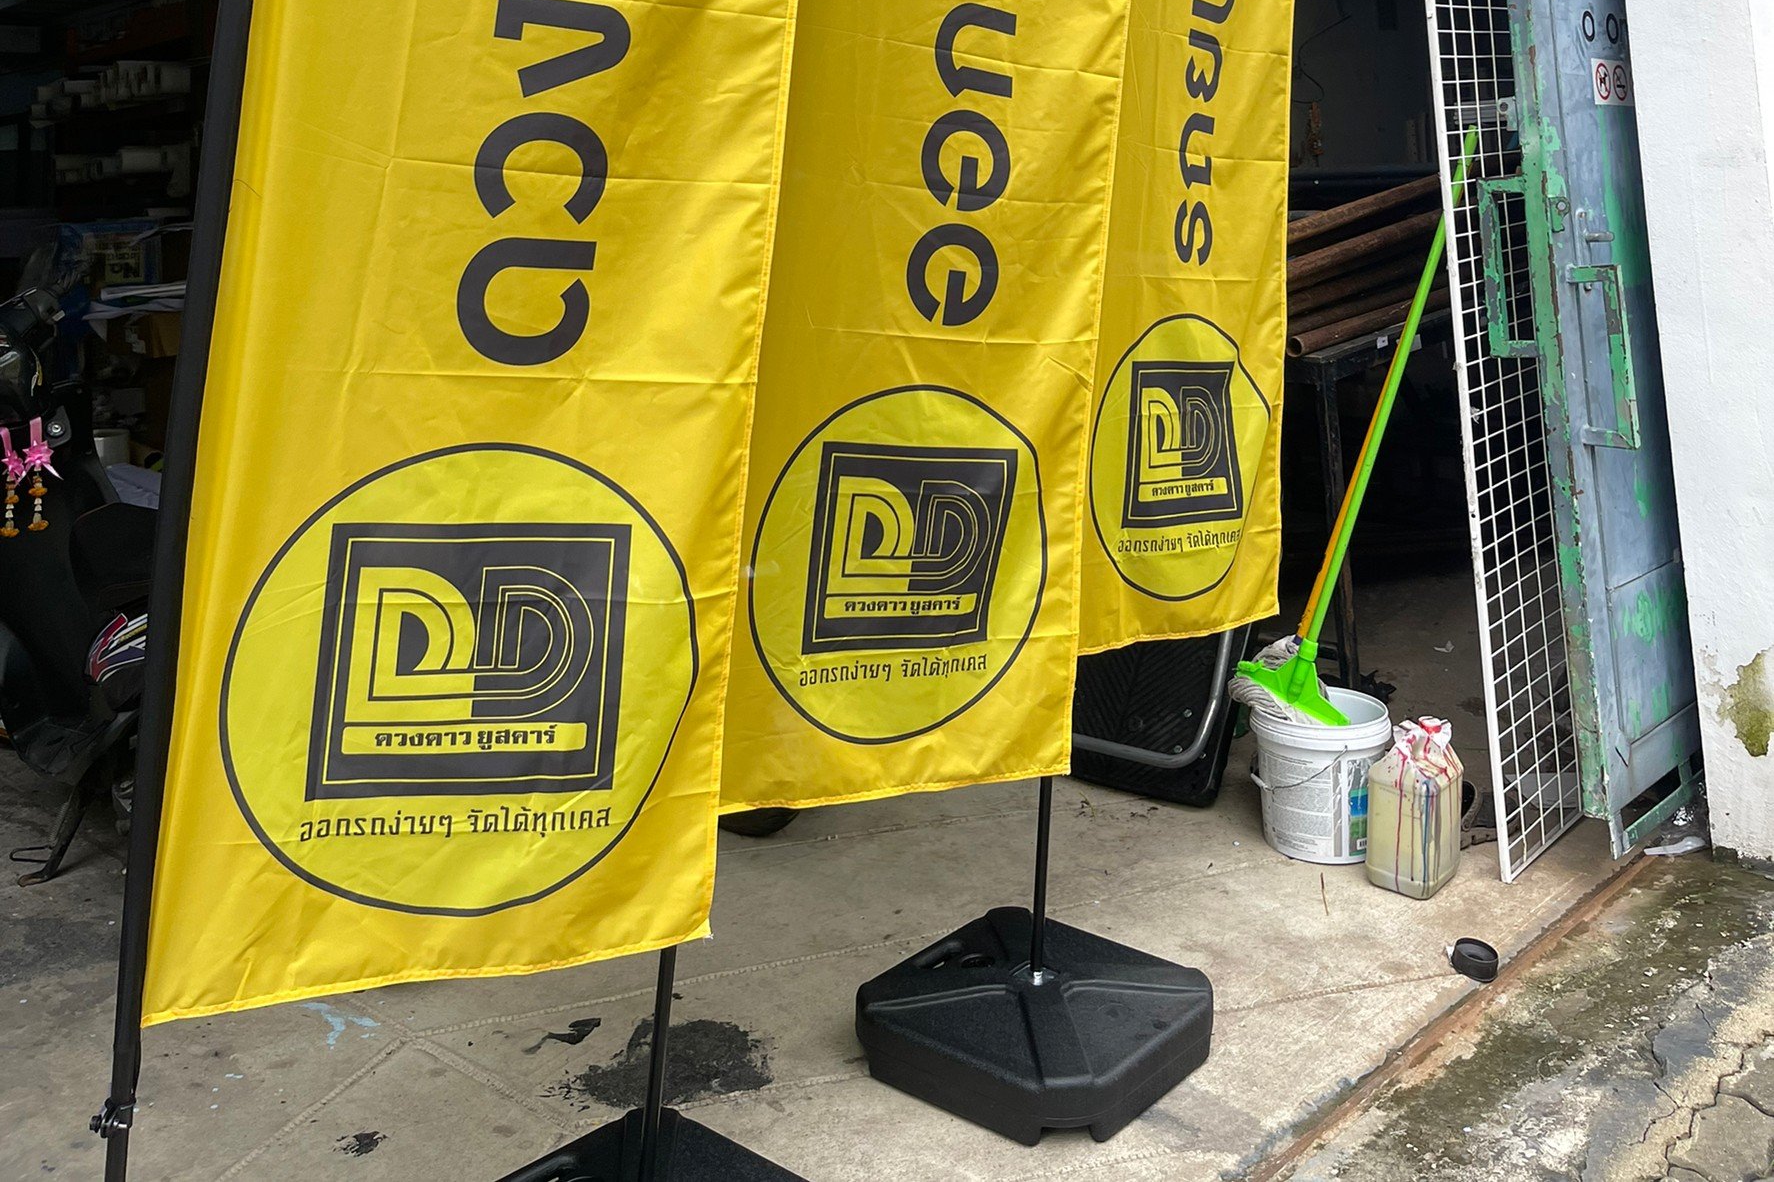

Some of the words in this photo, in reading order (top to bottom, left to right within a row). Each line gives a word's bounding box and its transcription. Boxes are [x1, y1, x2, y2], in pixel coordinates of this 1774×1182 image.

[1118, 536, 1183, 552] ออกรถง่ายๆ
[799, 660, 892, 686] ออกรถง่ายๆ
[901, 654, 987, 678] จัดได้ทุกเคส
[477, 725, 557, 750] ยูสคาร์
[300, 810, 452, 842] ออกรถง่ายๆ
[467, 806, 611, 837] จัดได้ทุกเคส
